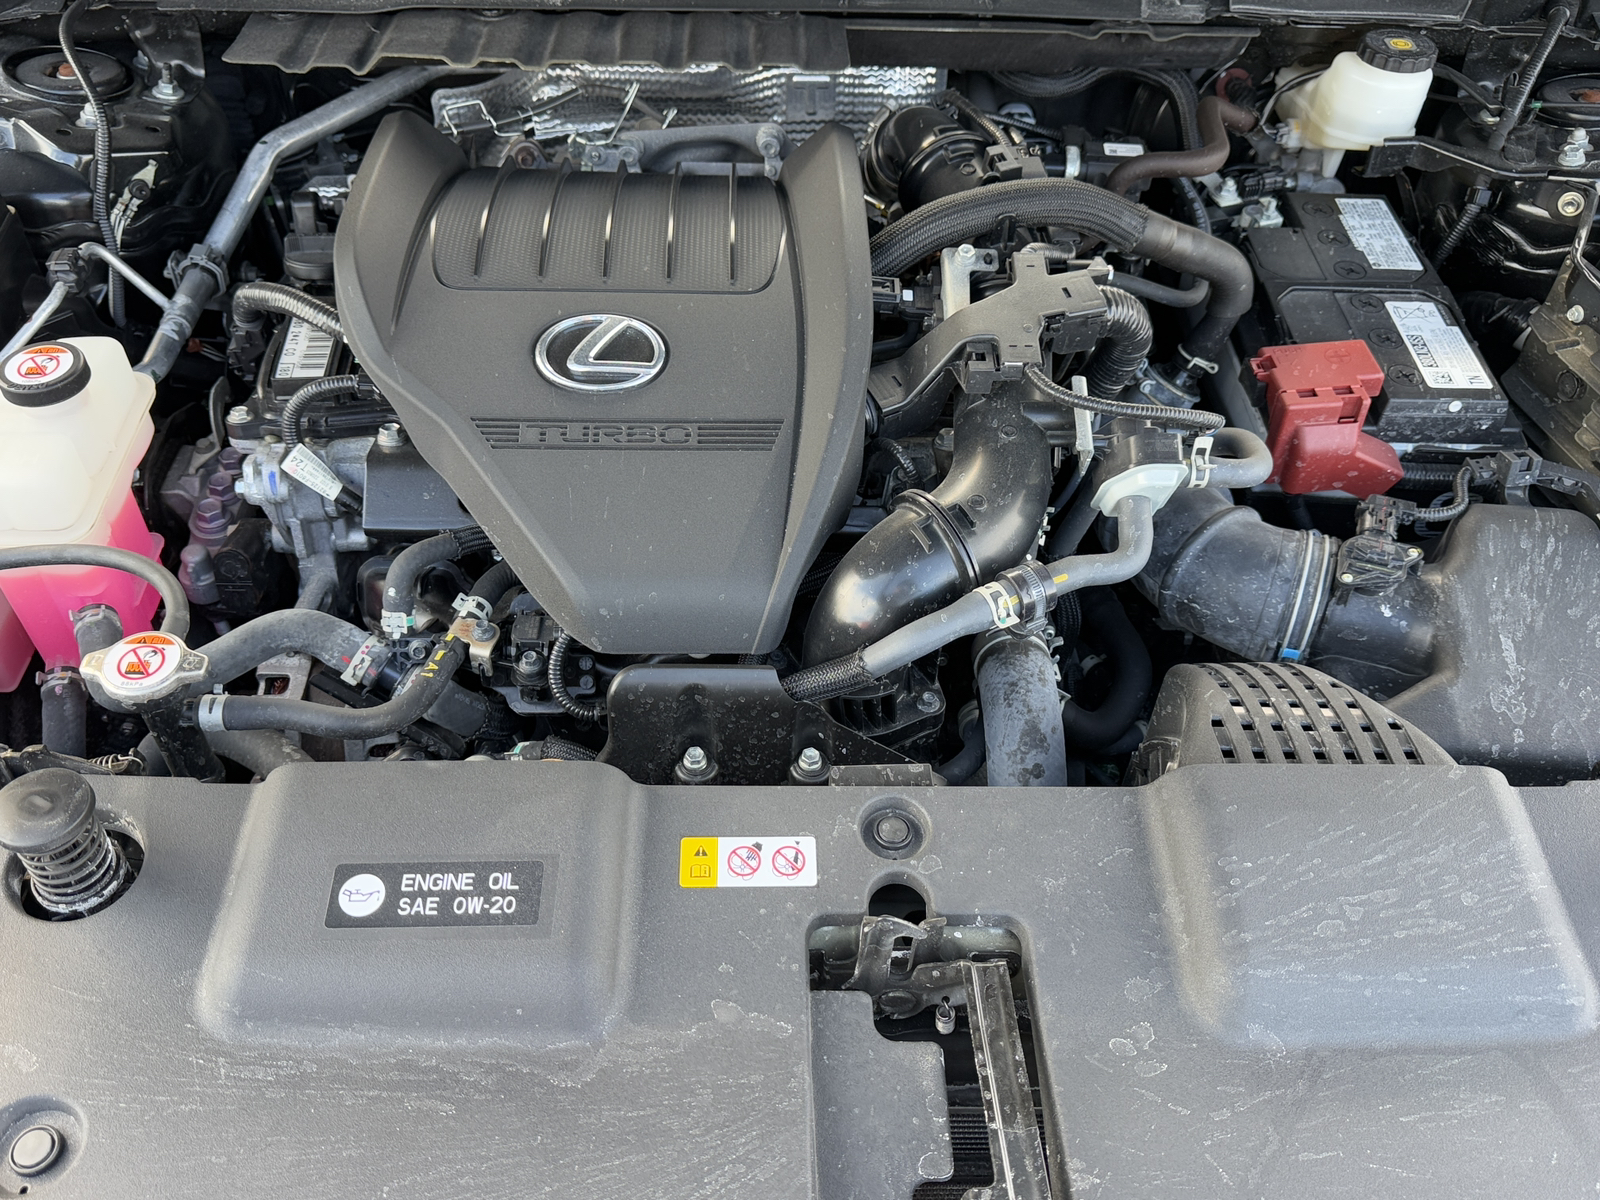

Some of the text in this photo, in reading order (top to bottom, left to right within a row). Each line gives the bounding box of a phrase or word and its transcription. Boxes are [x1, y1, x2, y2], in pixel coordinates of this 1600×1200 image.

[525, 423, 694, 445] TURBO
[400, 872, 519, 892] ENGINE OIL
[397, 896, 517, 916] SAE 0W-20
